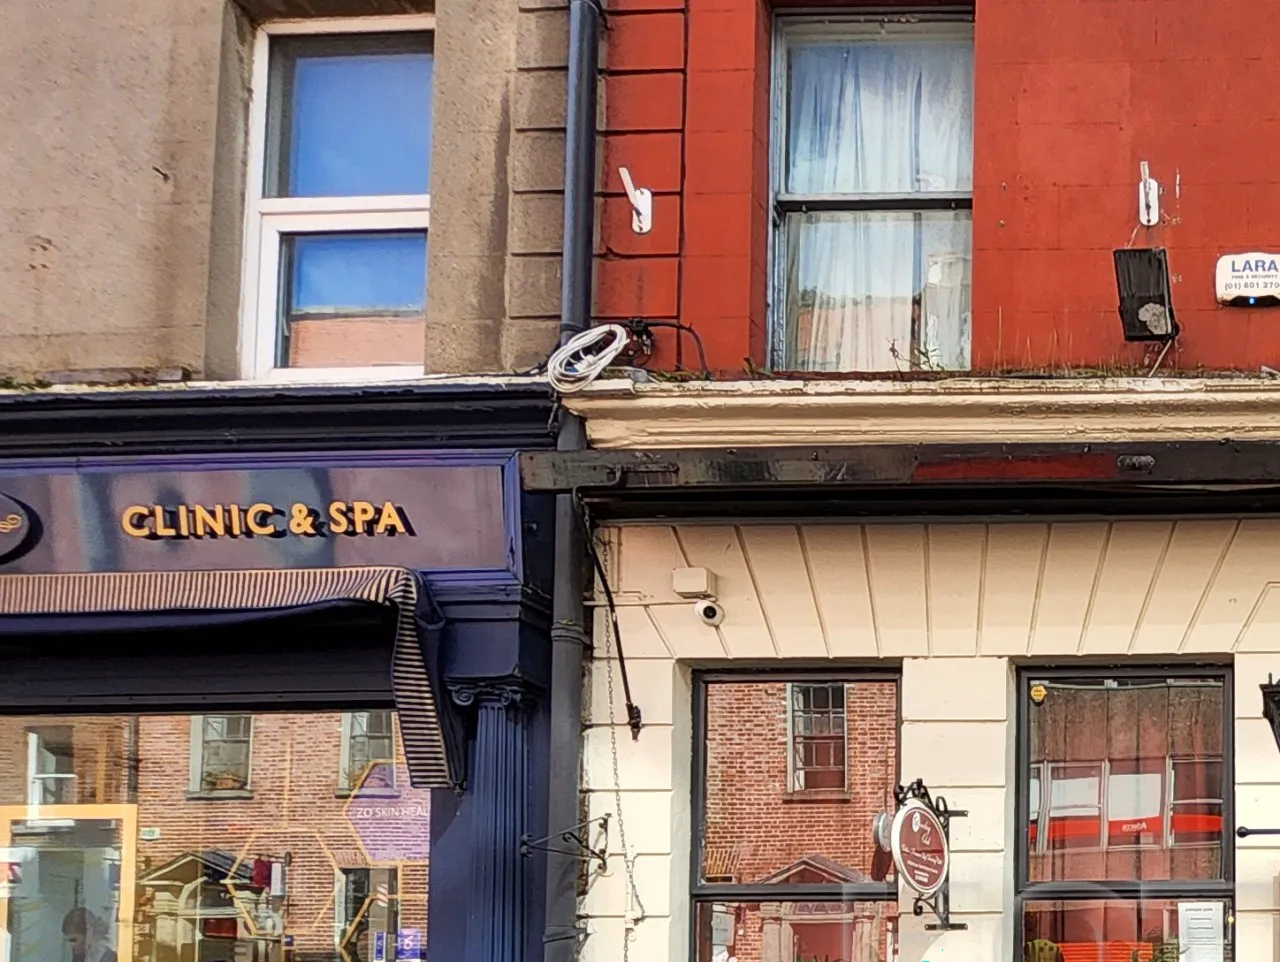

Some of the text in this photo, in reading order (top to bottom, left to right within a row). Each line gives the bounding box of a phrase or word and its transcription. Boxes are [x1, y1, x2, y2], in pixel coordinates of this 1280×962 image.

[1231, 259, 1279, 272] LARA
[1225, 282, 1242, 290] (01)
[121, 500, 409, 538] CLINIC & SPA
[356, 807, 373, 818] ZO
[375, 807, 400, 817] SKIN
